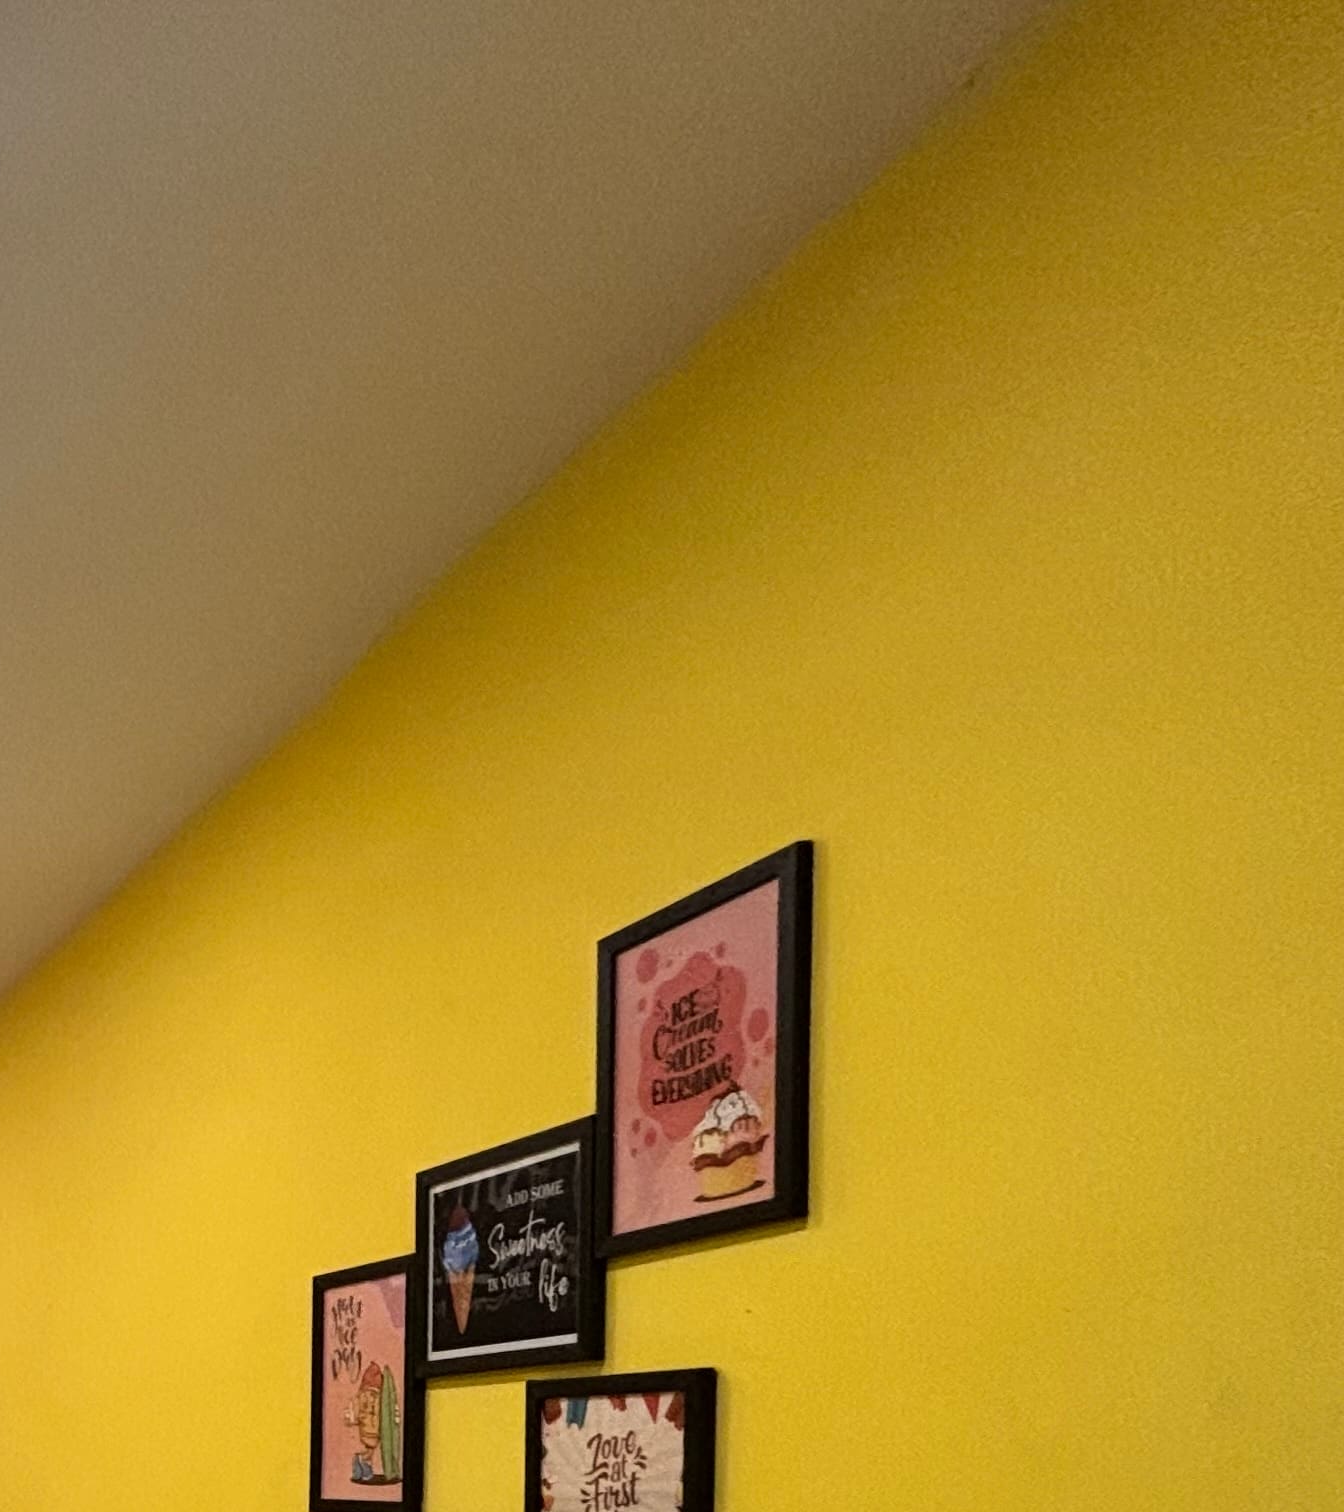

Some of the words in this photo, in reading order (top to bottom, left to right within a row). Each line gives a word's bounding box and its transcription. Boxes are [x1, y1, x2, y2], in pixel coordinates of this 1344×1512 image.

[672, 989, 700, 1026] ICE
[531, 1179, 564, 1201] SOME
[500, 1272, 532, 1290] YOUR
[584, 1430, 636, 1476] Love
[611, 1460, 628, 1482] at
[586, 1472, 639, 1512] First
